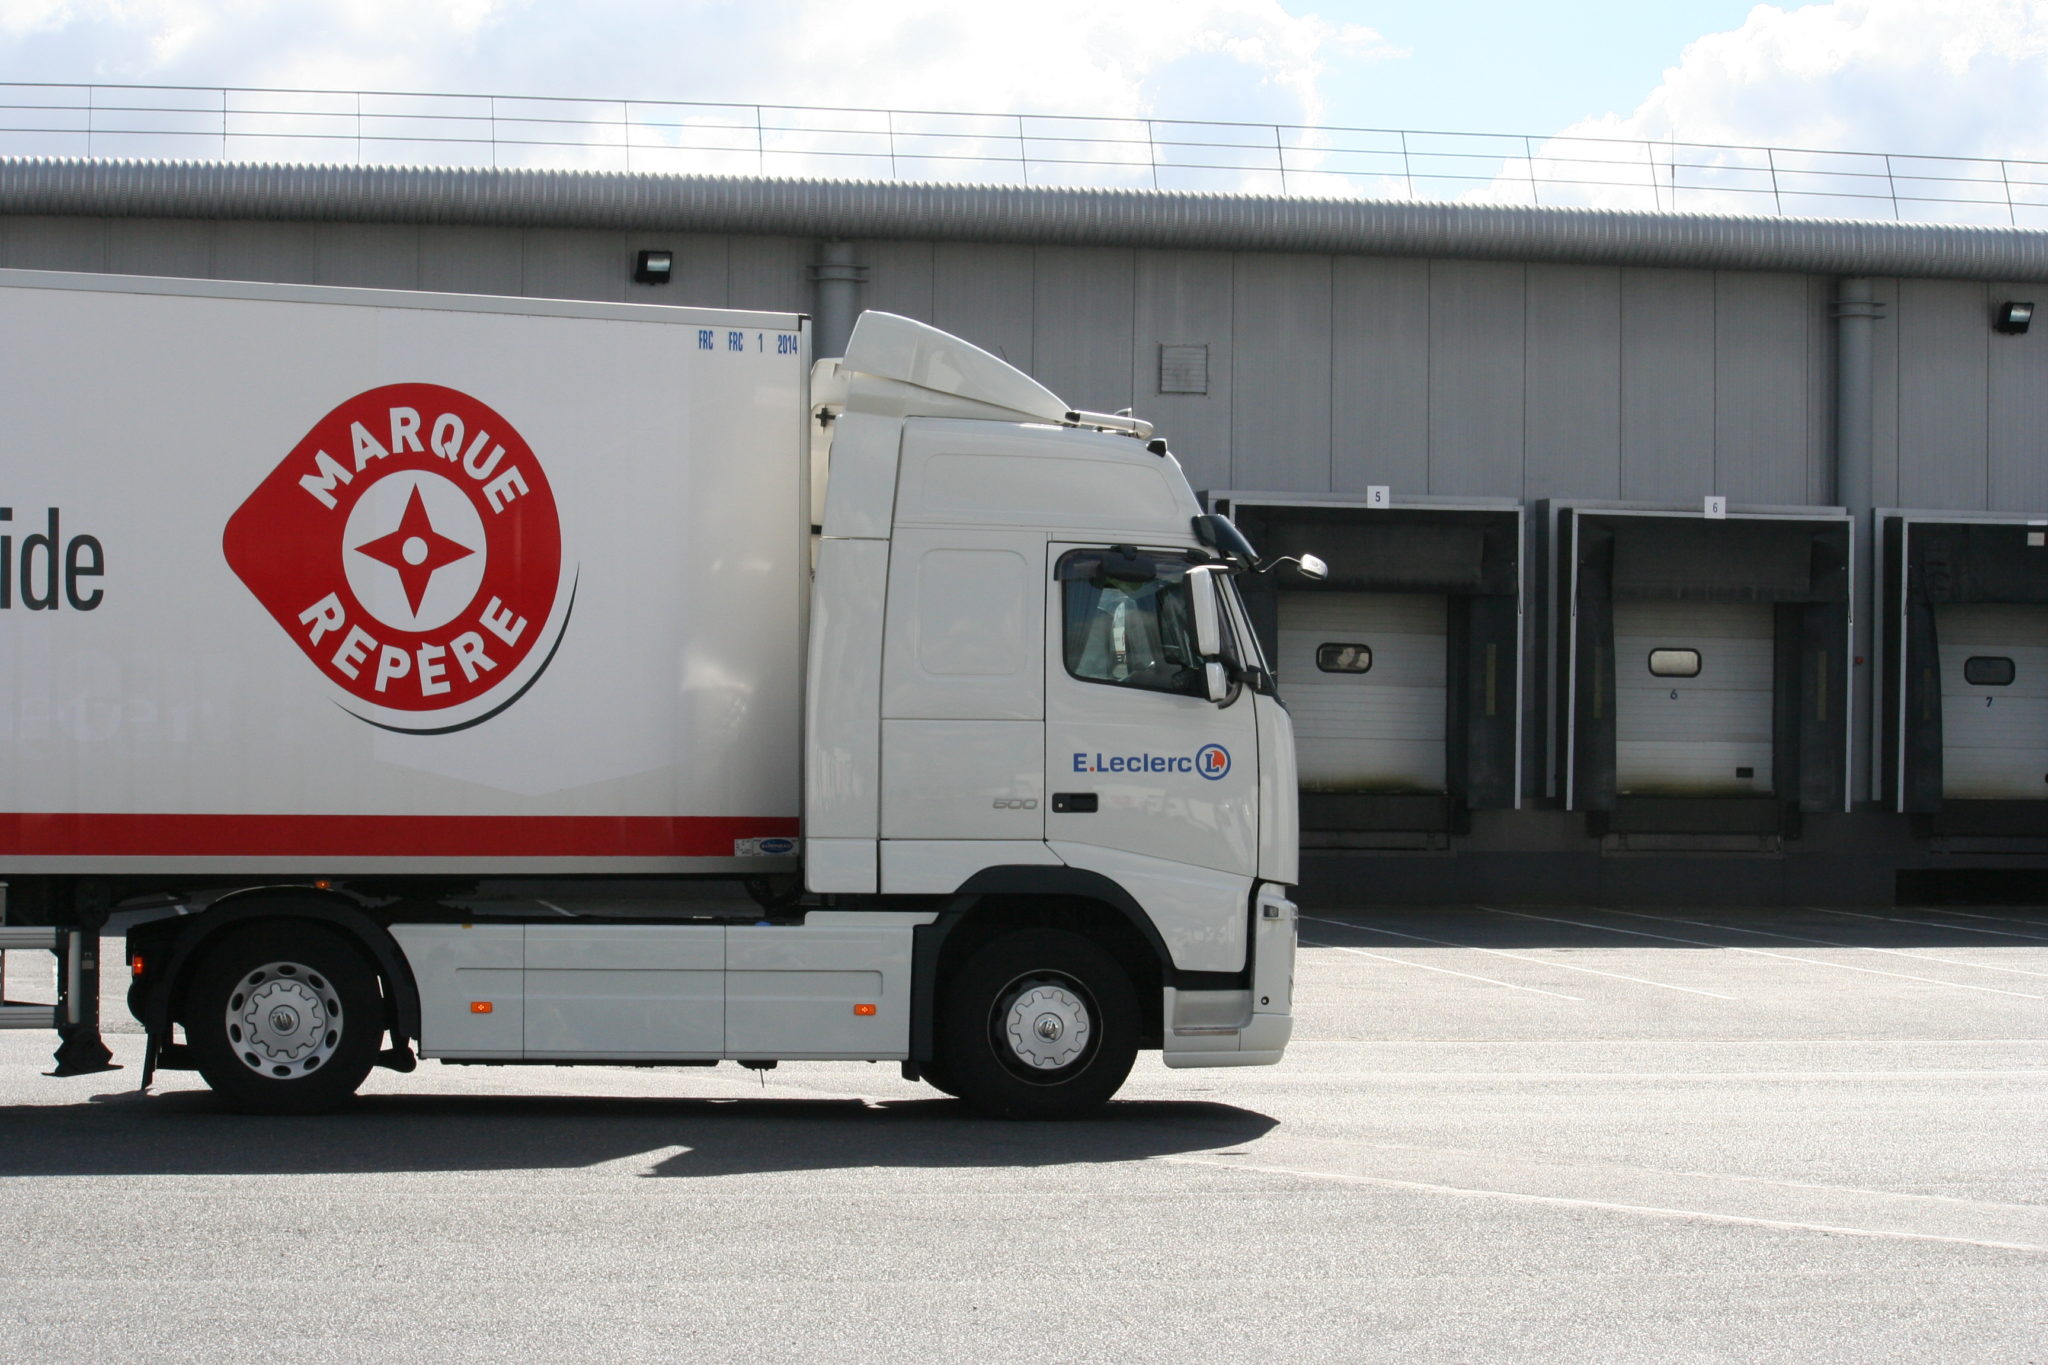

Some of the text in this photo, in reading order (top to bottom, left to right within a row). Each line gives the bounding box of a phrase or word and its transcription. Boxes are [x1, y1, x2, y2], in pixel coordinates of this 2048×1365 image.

[698, 330, 798, 355] FRC FRC 1 2014
[298, 406, 530, 511] MARQUE
[1375, 491, 1382, 503] 5
[1712, 502, 1719, 513] 6
[0, 507, 105, 612] ide
[298, 592, 528, 697] REPÈRE
[1670, 689, 1678, 700] 6
[1985, 696, 1993, 708] 7
[1073, 753, 1193, 773] E.Leclerc
